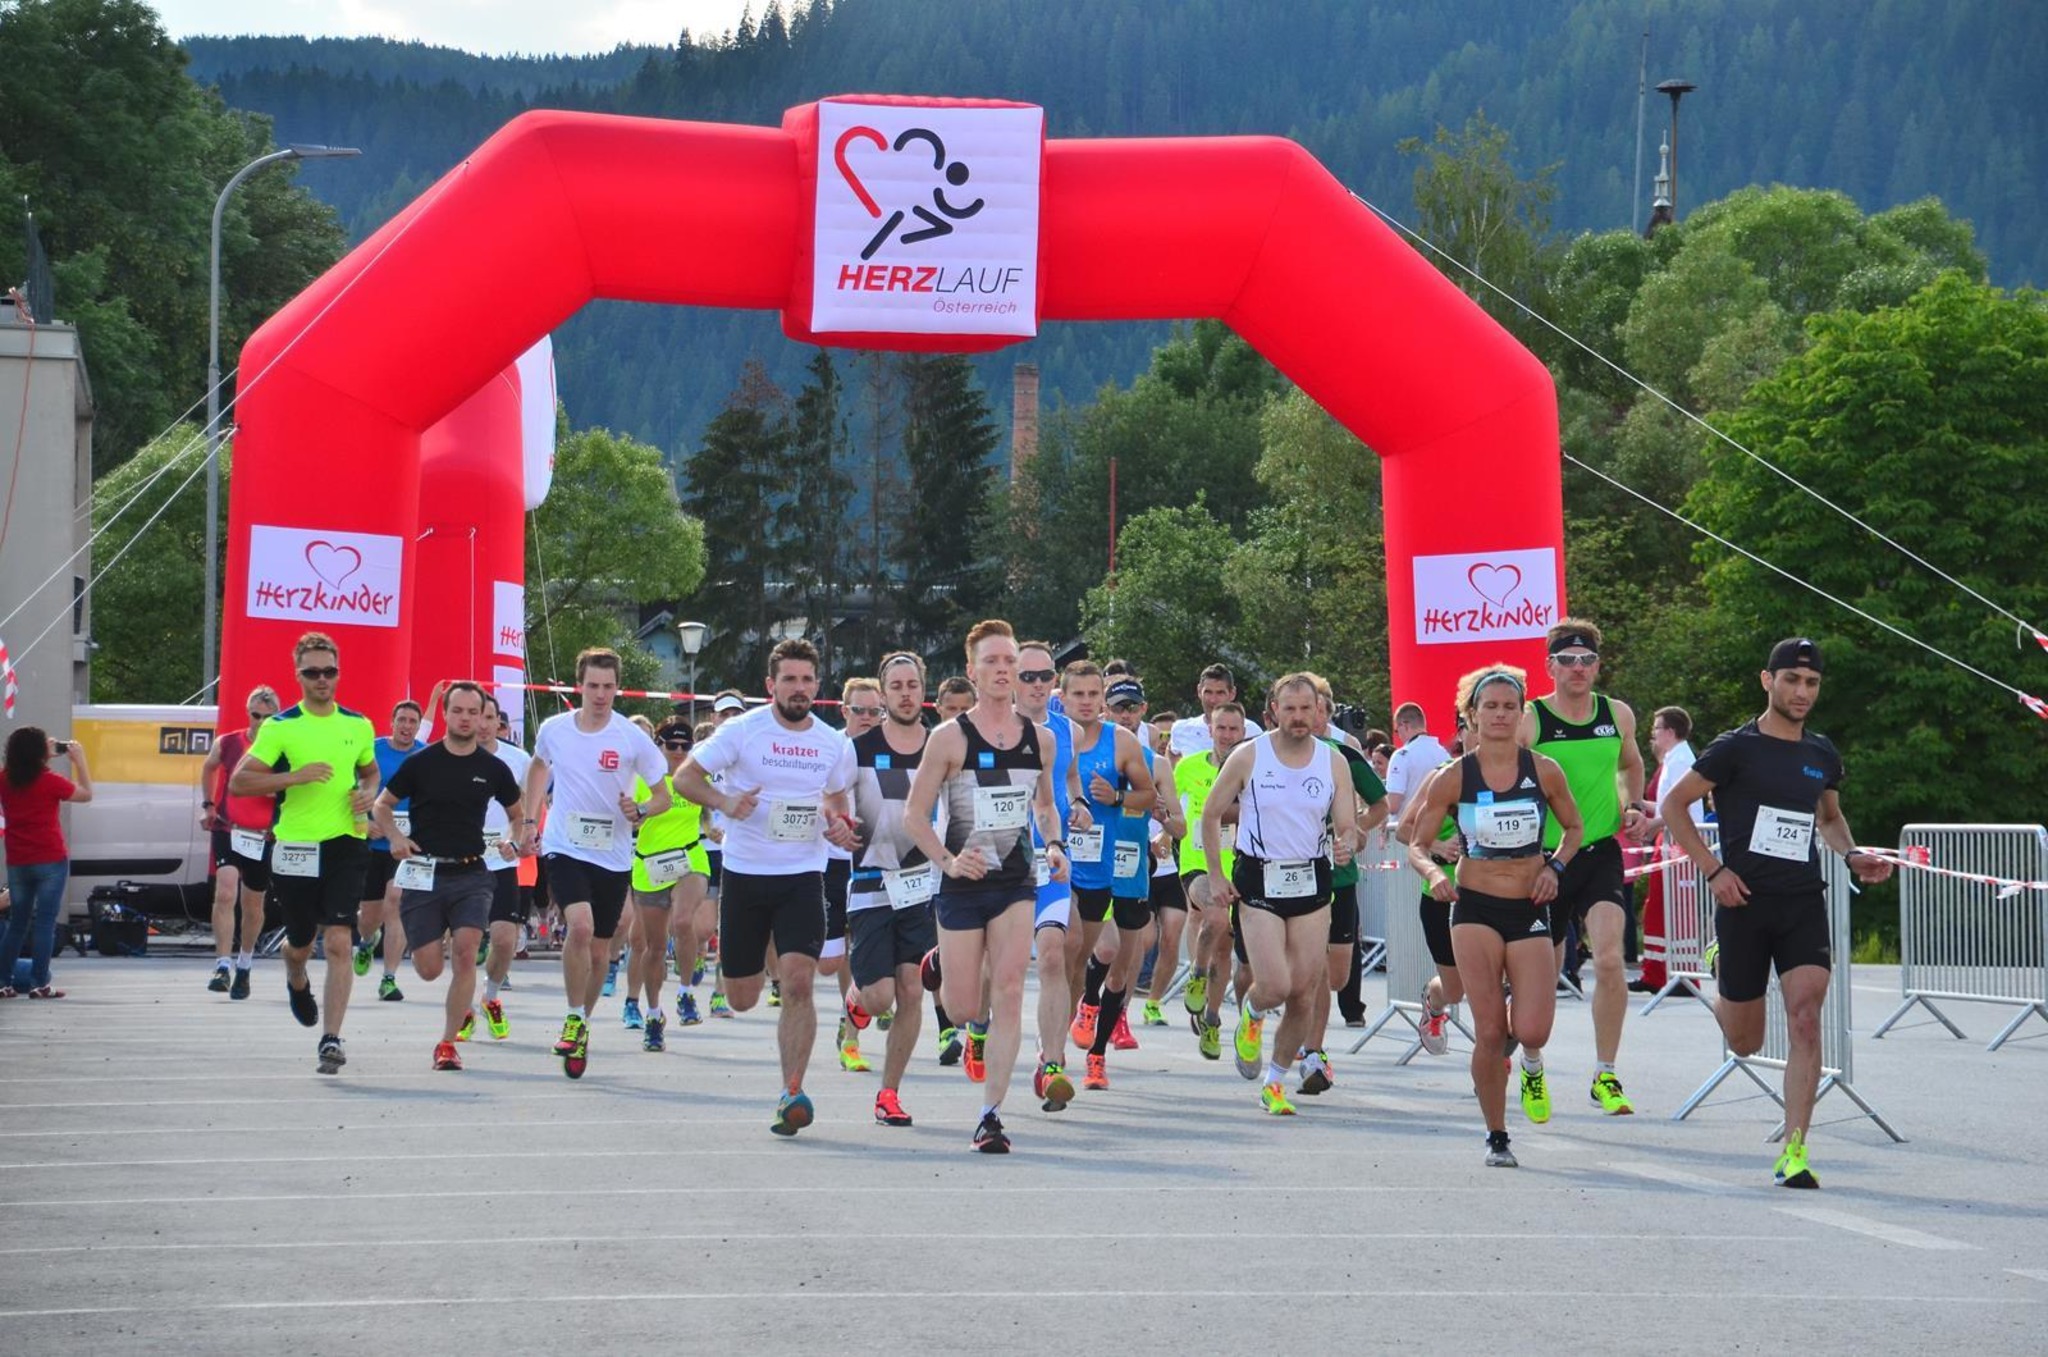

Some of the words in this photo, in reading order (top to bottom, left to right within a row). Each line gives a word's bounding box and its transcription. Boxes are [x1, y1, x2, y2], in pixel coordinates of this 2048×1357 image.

[837, 264, 1023, 293] HERZLAUF
[932, 297, 1017, 314] Österreich
[772, 742, 819, 757] kratzer
[993, 800, 1015, 812] 120
[782, 813, 810, 824] 3073
[583, 825, 596, 835] 87
[1496, 819, 1521, 832] 119
[1776, 826, 1799, 841] 124
[1070, 836, 1084, 847] 40
[281, 852, 307, 863] 3273
[662, 864, 675, 873] 30
[1284, 872, 1298, 882] 26
[903, 878, 923, 890] 127
